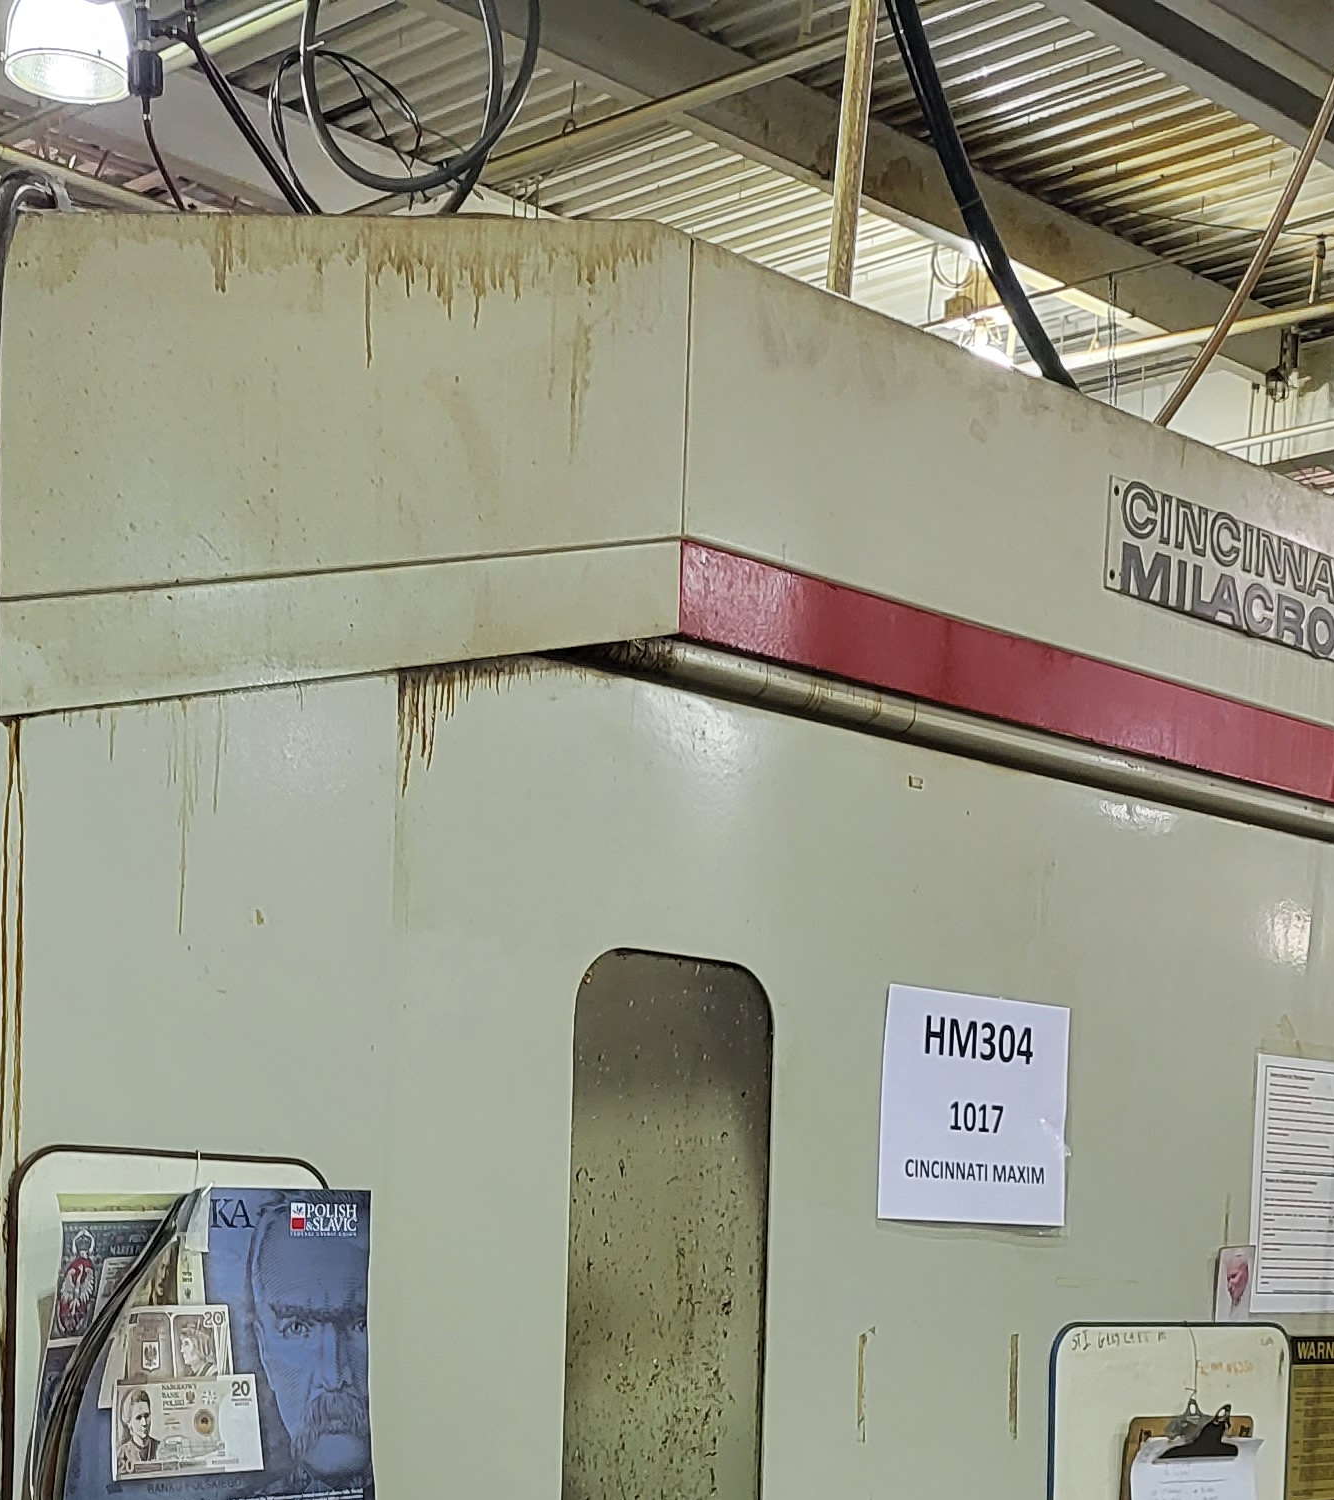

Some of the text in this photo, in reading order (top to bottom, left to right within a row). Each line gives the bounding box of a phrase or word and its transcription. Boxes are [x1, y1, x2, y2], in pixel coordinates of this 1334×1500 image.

[924, 1014, 1034, 1066] HM304
[949, 1100, 1005, 1134] 1017
[904, 1158, 1046, 1186] CINCINNATI MAXIM
[306, 1203, 358, 1218] POLISH
[203, 1311, 224, 1326] 20
[231, 1380, 251, 1397] 20
